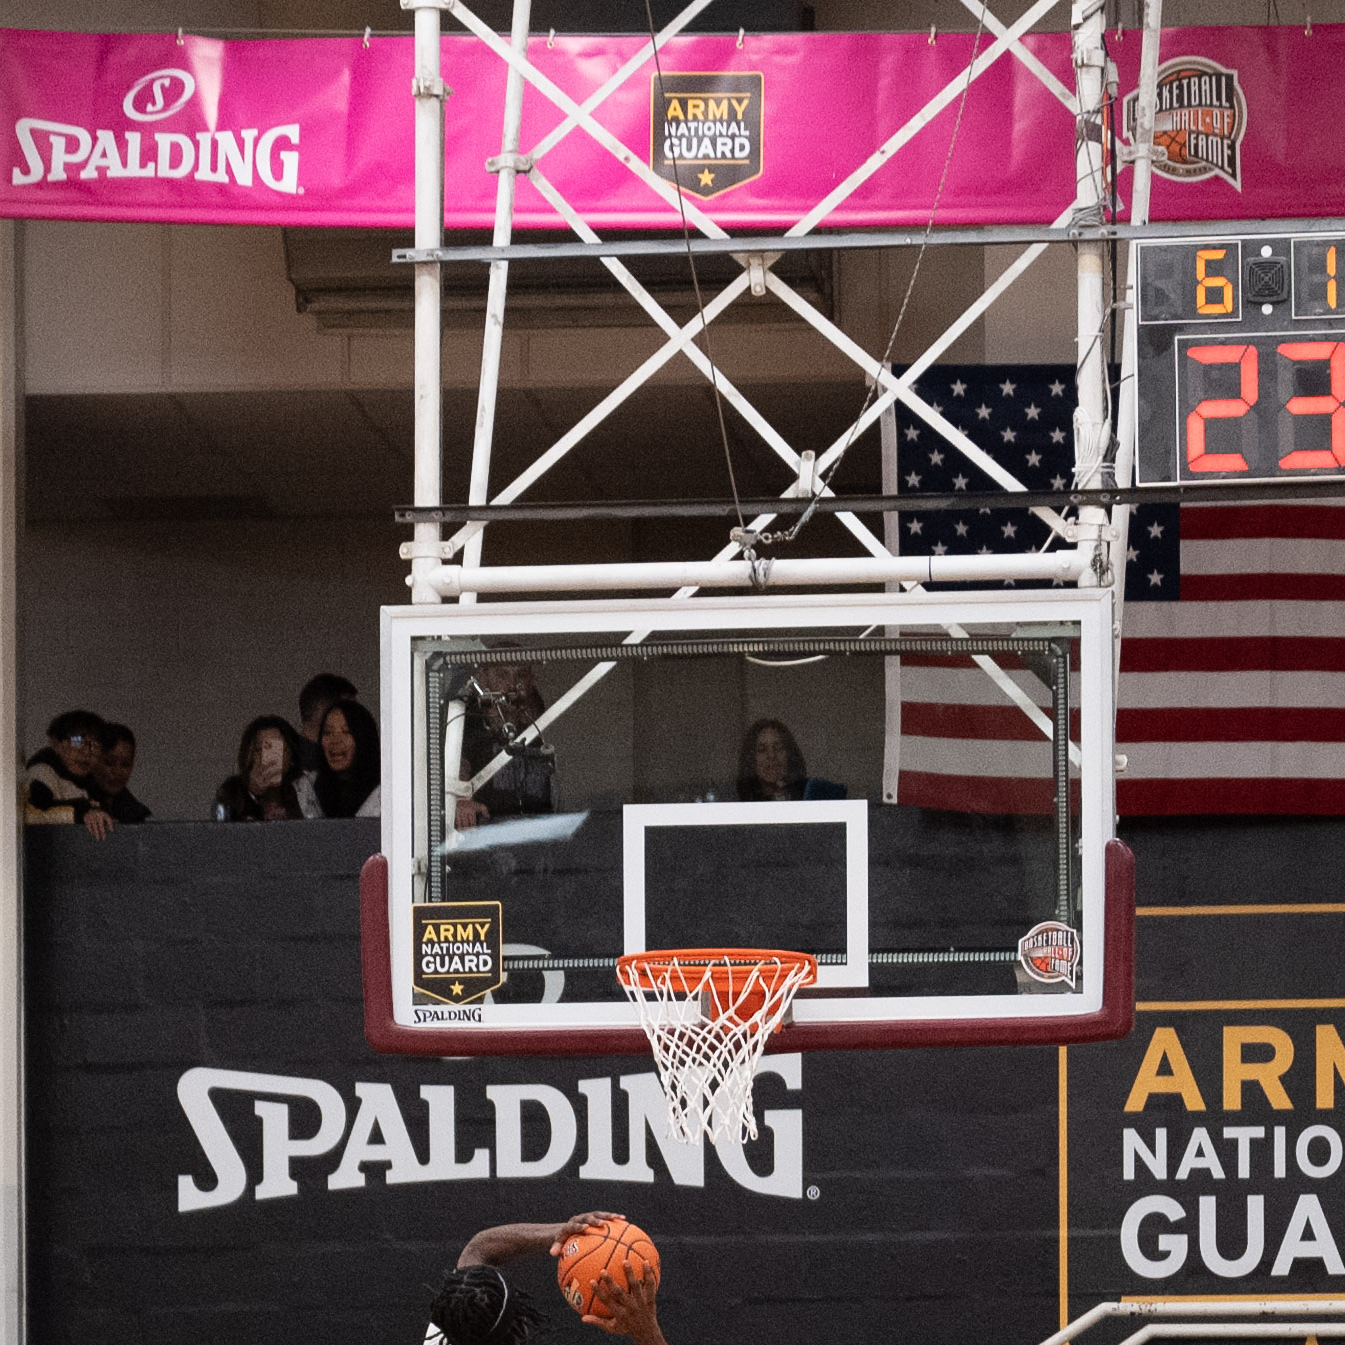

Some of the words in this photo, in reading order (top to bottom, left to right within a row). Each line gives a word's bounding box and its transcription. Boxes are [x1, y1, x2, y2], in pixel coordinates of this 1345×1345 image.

[1136, 75, 1231, 112] KETBALL
[667, 98, 749, 120] ARMY
[664, 121, 750, 137] NATIONAL
[1171, 109, 1203, 131] HALL
[1211, 110, 1232, 139] OF
[11, 117, 300, 195] SPALDING
[663, 137, 751, 159] GUARD
[1188, 133, 1233, 174] FAME
[422, 923, 491, 942] ARMY
[421, 943, 491, 955] NATIONAL
[421, 955, 493, 973] GUARD
[414, 1007, 483, 1024] SPALDING
[177, 1052, 804, 1212] SPALDING
